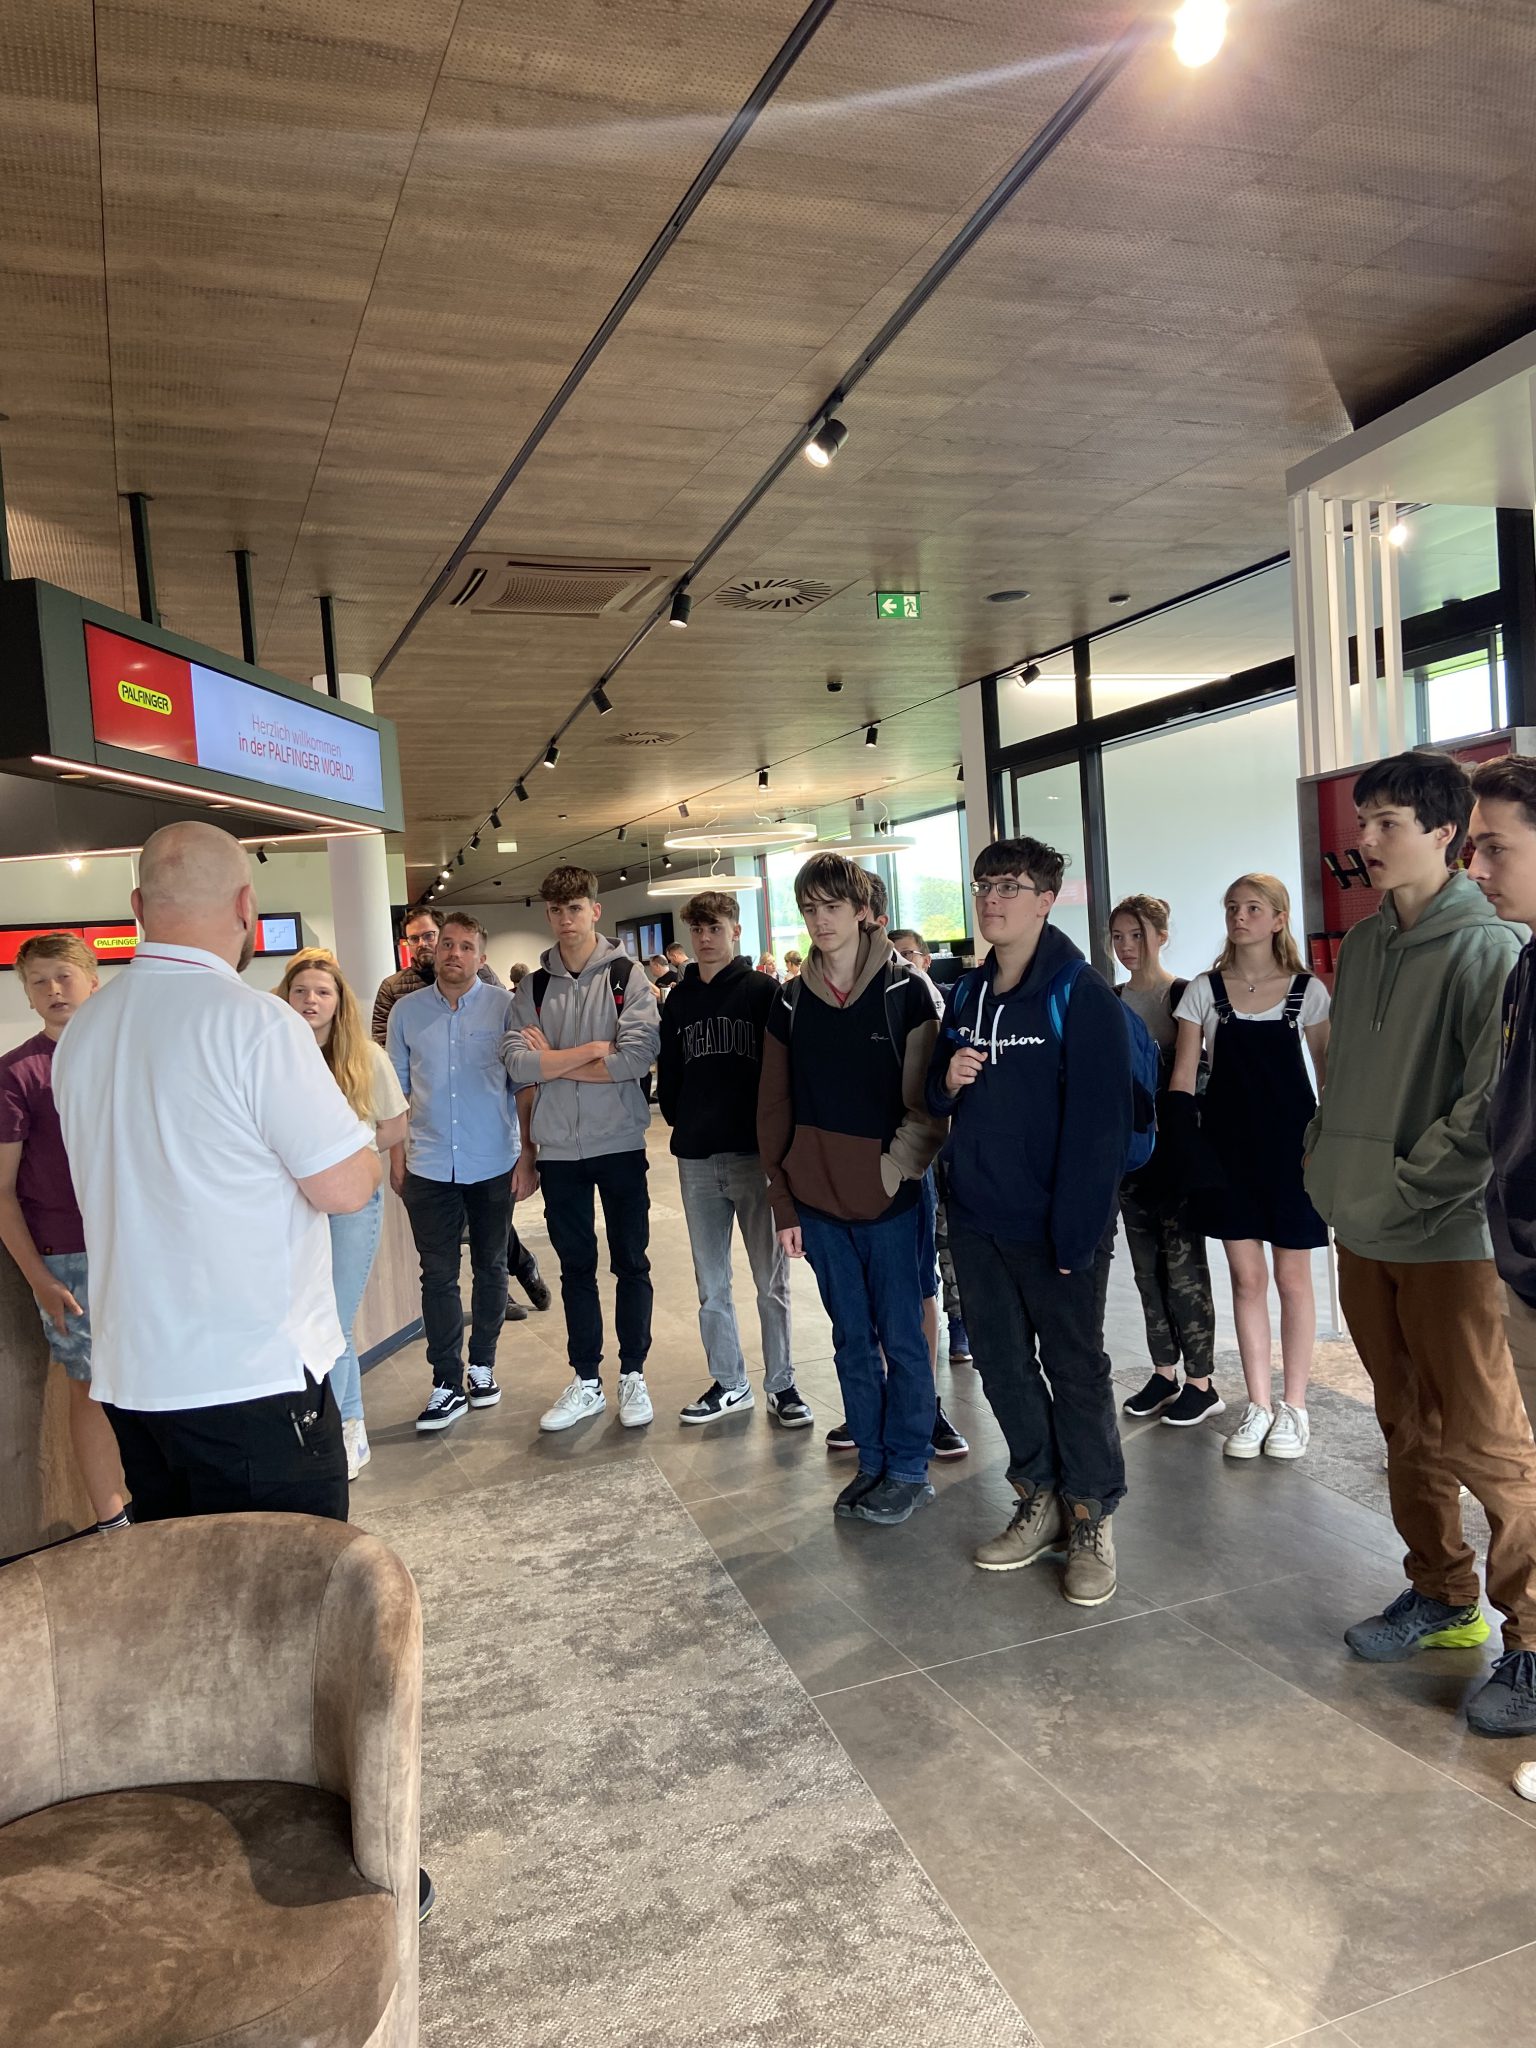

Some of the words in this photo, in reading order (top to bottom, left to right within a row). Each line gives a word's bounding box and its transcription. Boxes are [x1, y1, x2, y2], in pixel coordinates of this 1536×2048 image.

[121, 684, 169, 711] PALFINGER
[238, 731, 248, 753] in
[250, 737, 266, 756] der
[268, 741, 320, 773] PALFINGER
[321, 757, 355, 781] WORLD!
[251, 712, 291, 742] Herzlich
[292, 729, 342, 758] willkommen
[677, 1016, 759, 1064] EGADO
[958, 1026, 1046, 1055] Champion
